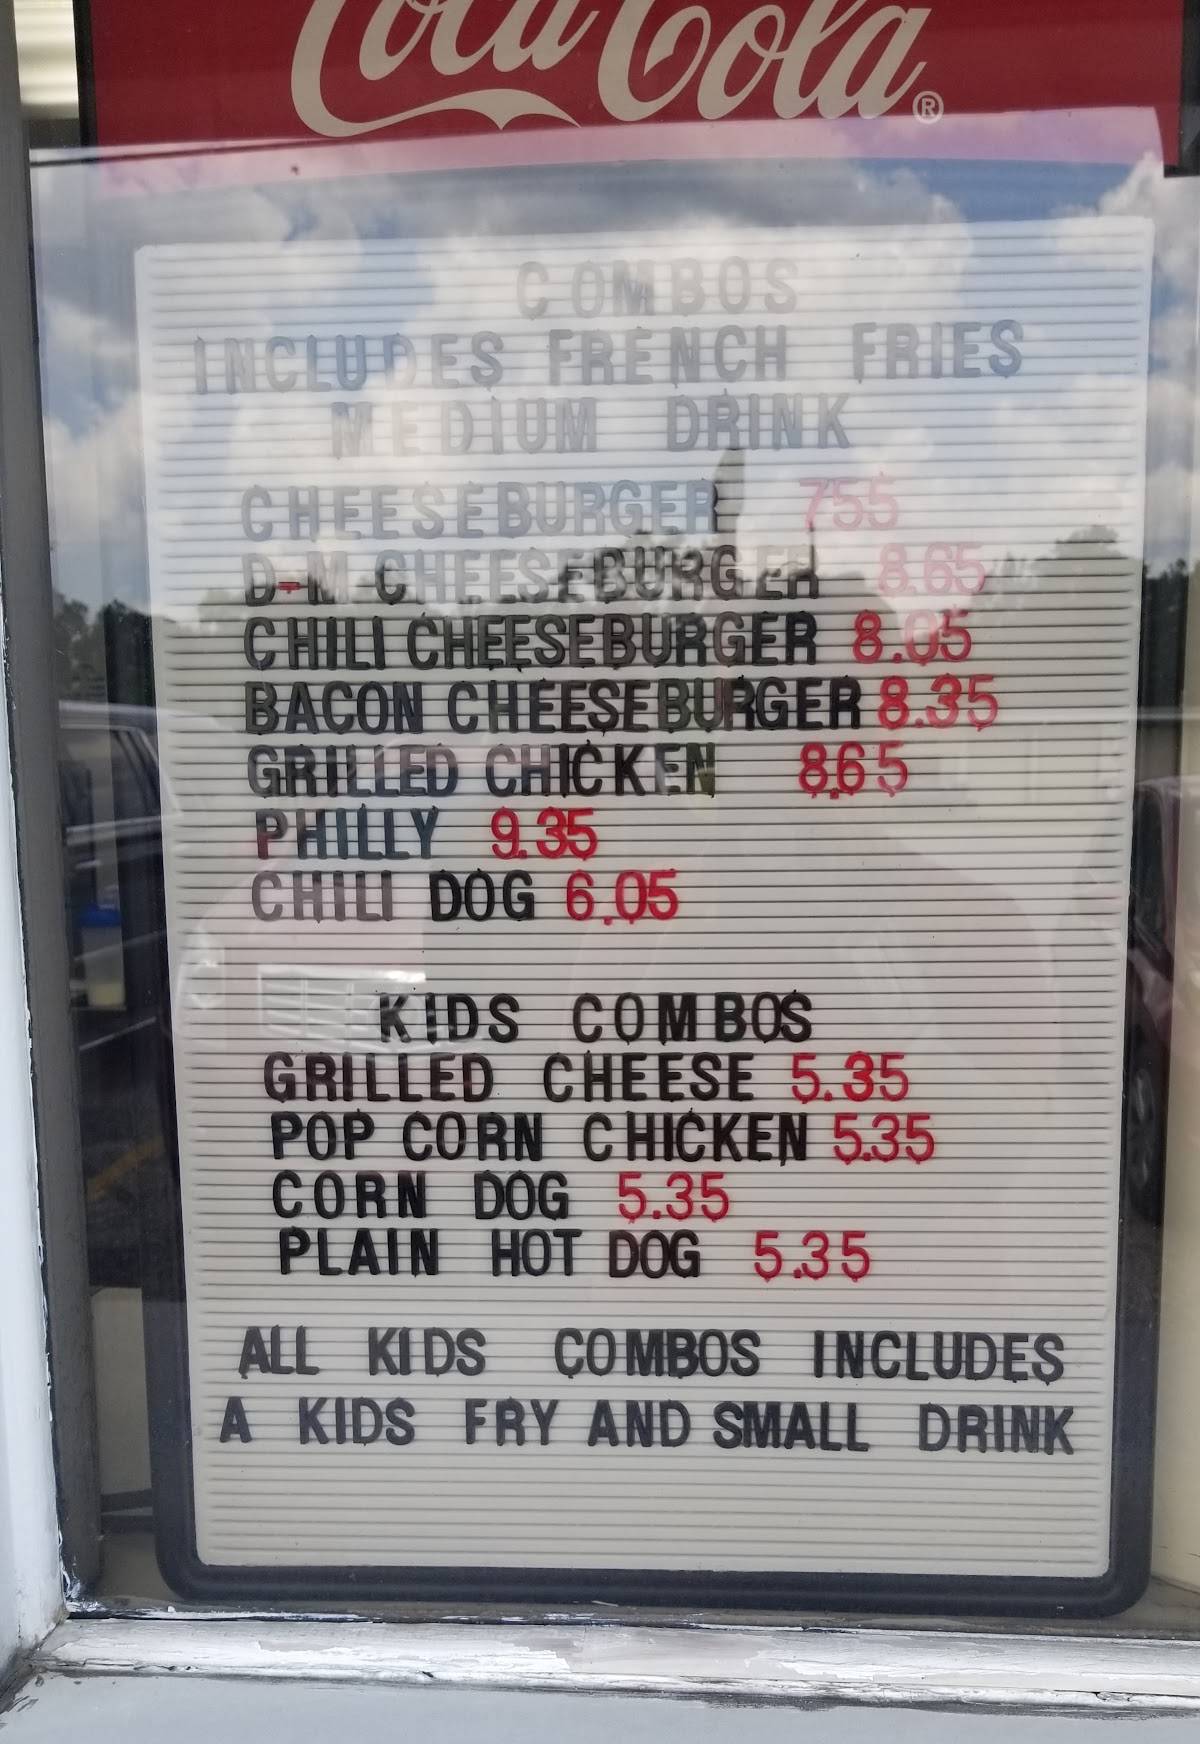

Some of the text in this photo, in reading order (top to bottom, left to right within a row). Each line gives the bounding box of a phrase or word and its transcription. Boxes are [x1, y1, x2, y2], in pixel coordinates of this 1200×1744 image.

[516, 256, 799, 320] COMBOS
[194, 319, 1024, 395] INCLUDES FRENCH FRIES
[331, 391, 851, 459] MEDIUM DRINK
[241, 479, 718, 541] CHEESEBURGER
[374, 545, 820, 605] CHEESEBURGER
[878, 541, 987, 597] 8.65
[243, 606, 973, 671] CHILI CHEESEBURGER 8.05
[245, 674, 999, 735] BACON CHEESEBURGER 8.35
[247, 740, 909, 800] GRILLED CHICKEN 8.65
[255, 804, 598, 860] PHILLY 9.35
[251, 869, 680, 925] CHILI DOG 6.05
[379, 990, 813, 1045] KIDS COMBOS
[263, 1050, 909, 1103] GRILLED CHEESE 5.35
[270, 1108, 936, 1166] POP CORN CHICKEN 5.35
[272, 1169, 730, 1223] CORN DOG 5.35
[279, 1226, 872, 1283] PLAIN HOT DOG 5.35
[238, 1325, 1065, 1386] ALL KIDS COMBOS INCLUDES
[219, 1396, 1075, 1456] A KIDS FRY AND SMALL DRINK
